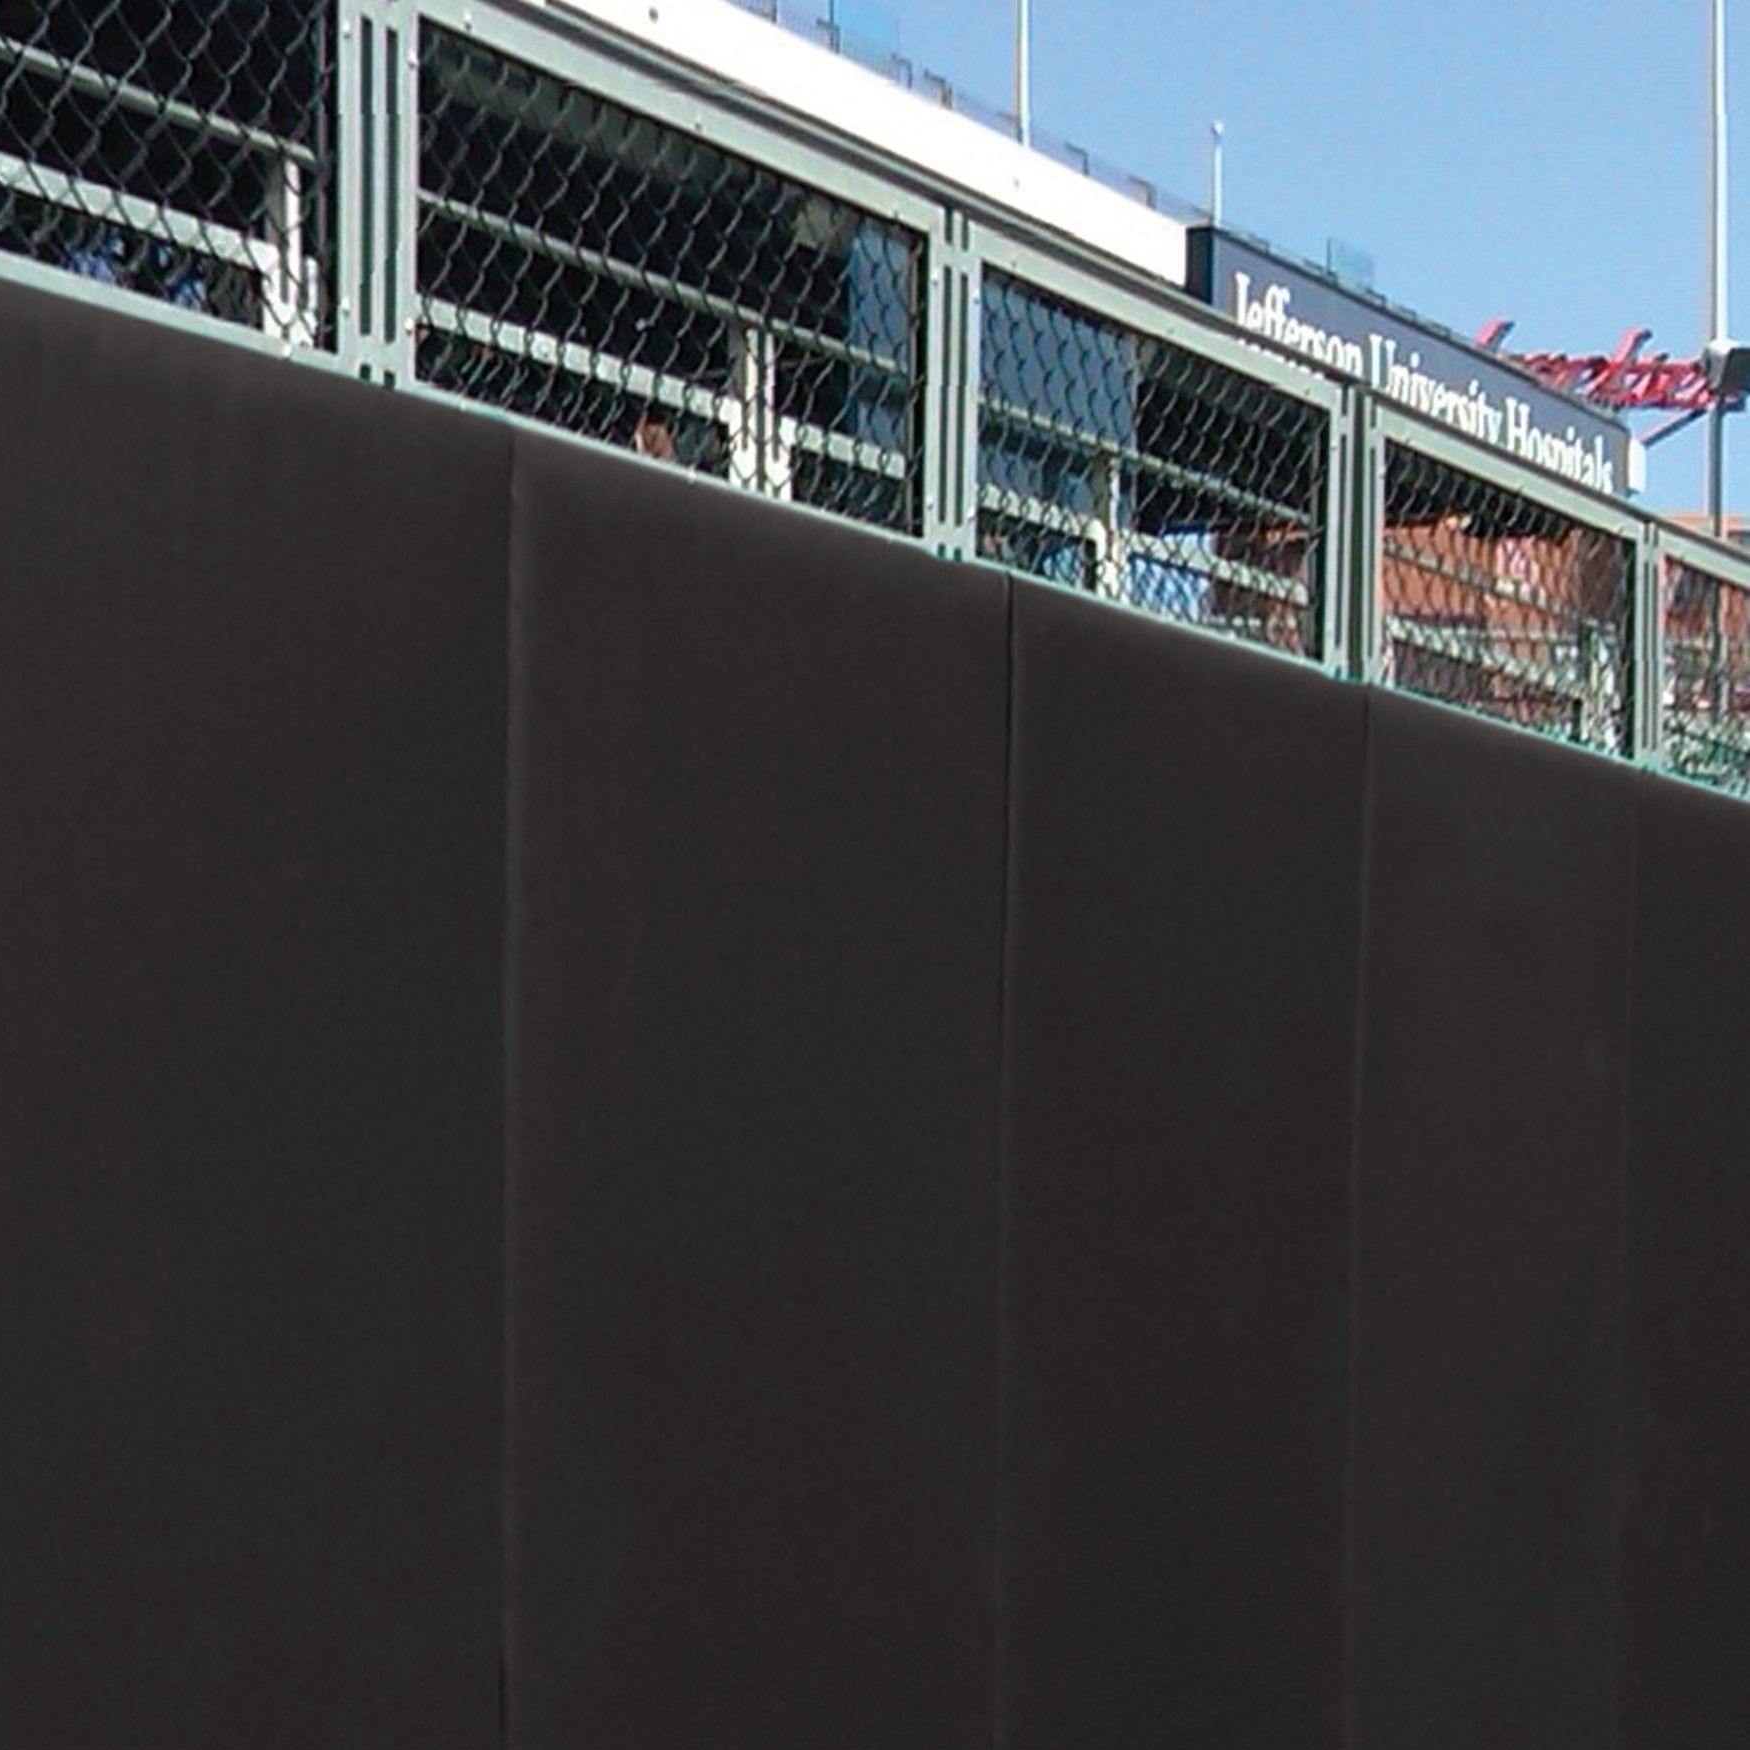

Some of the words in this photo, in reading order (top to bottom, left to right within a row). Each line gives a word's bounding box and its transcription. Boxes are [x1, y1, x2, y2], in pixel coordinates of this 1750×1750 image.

[1235, 272, 1363, 379] Jefferson
[1369, 333, 1501, 444] University
[1506, 397, 1612, 494] Hospitals
